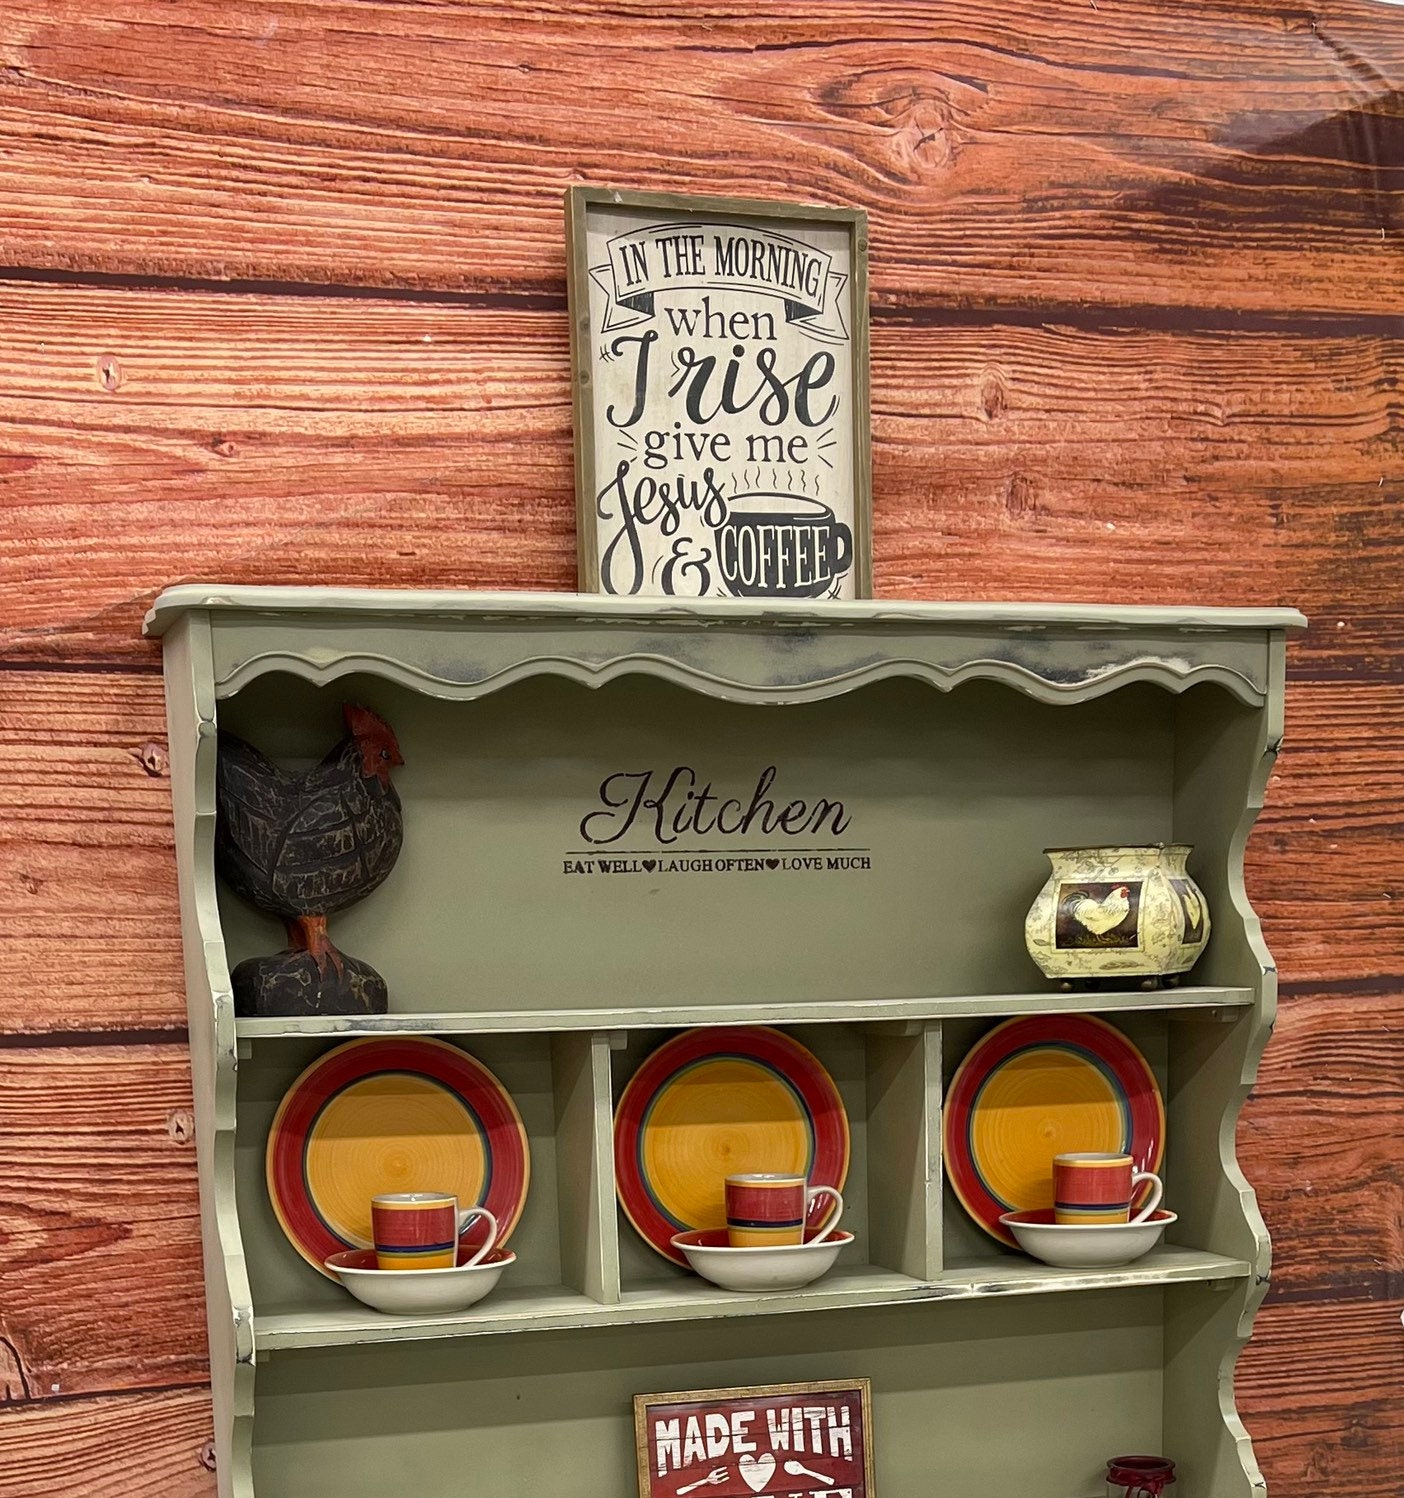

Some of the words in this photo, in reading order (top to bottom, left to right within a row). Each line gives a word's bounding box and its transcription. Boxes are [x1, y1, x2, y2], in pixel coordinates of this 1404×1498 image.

[619, 240, 650, 287] IN
[655, 234, 706, 279] THE
[713, 235, 823, 298] MORNING
[664, 296, 777, 340] when
[606, 329, 659, 428] I
[667, 344, 838, 428] rise
[643, 421, 731, 469] give
[745, 434, 809, 464] me
[596, 459, 728, 596] Jesus
[660, 536, 712, 597] &
[721, 524, 832, 590] COFFEE
[579, 765, 852, 845] Kitchen
[562, 859, 595, 874] EAT
[597, 858, 643, 874] WELL
[657, 858, 713, 873] LAUGH
[714, 858, 765, 872] OFTEN
[782, 857, 823, 871] LOVE
[826, 856, 871, 870] MUCH
[655, 1410, 757, 1478] MADE
[766, 1405, 853, 1462] WITH
